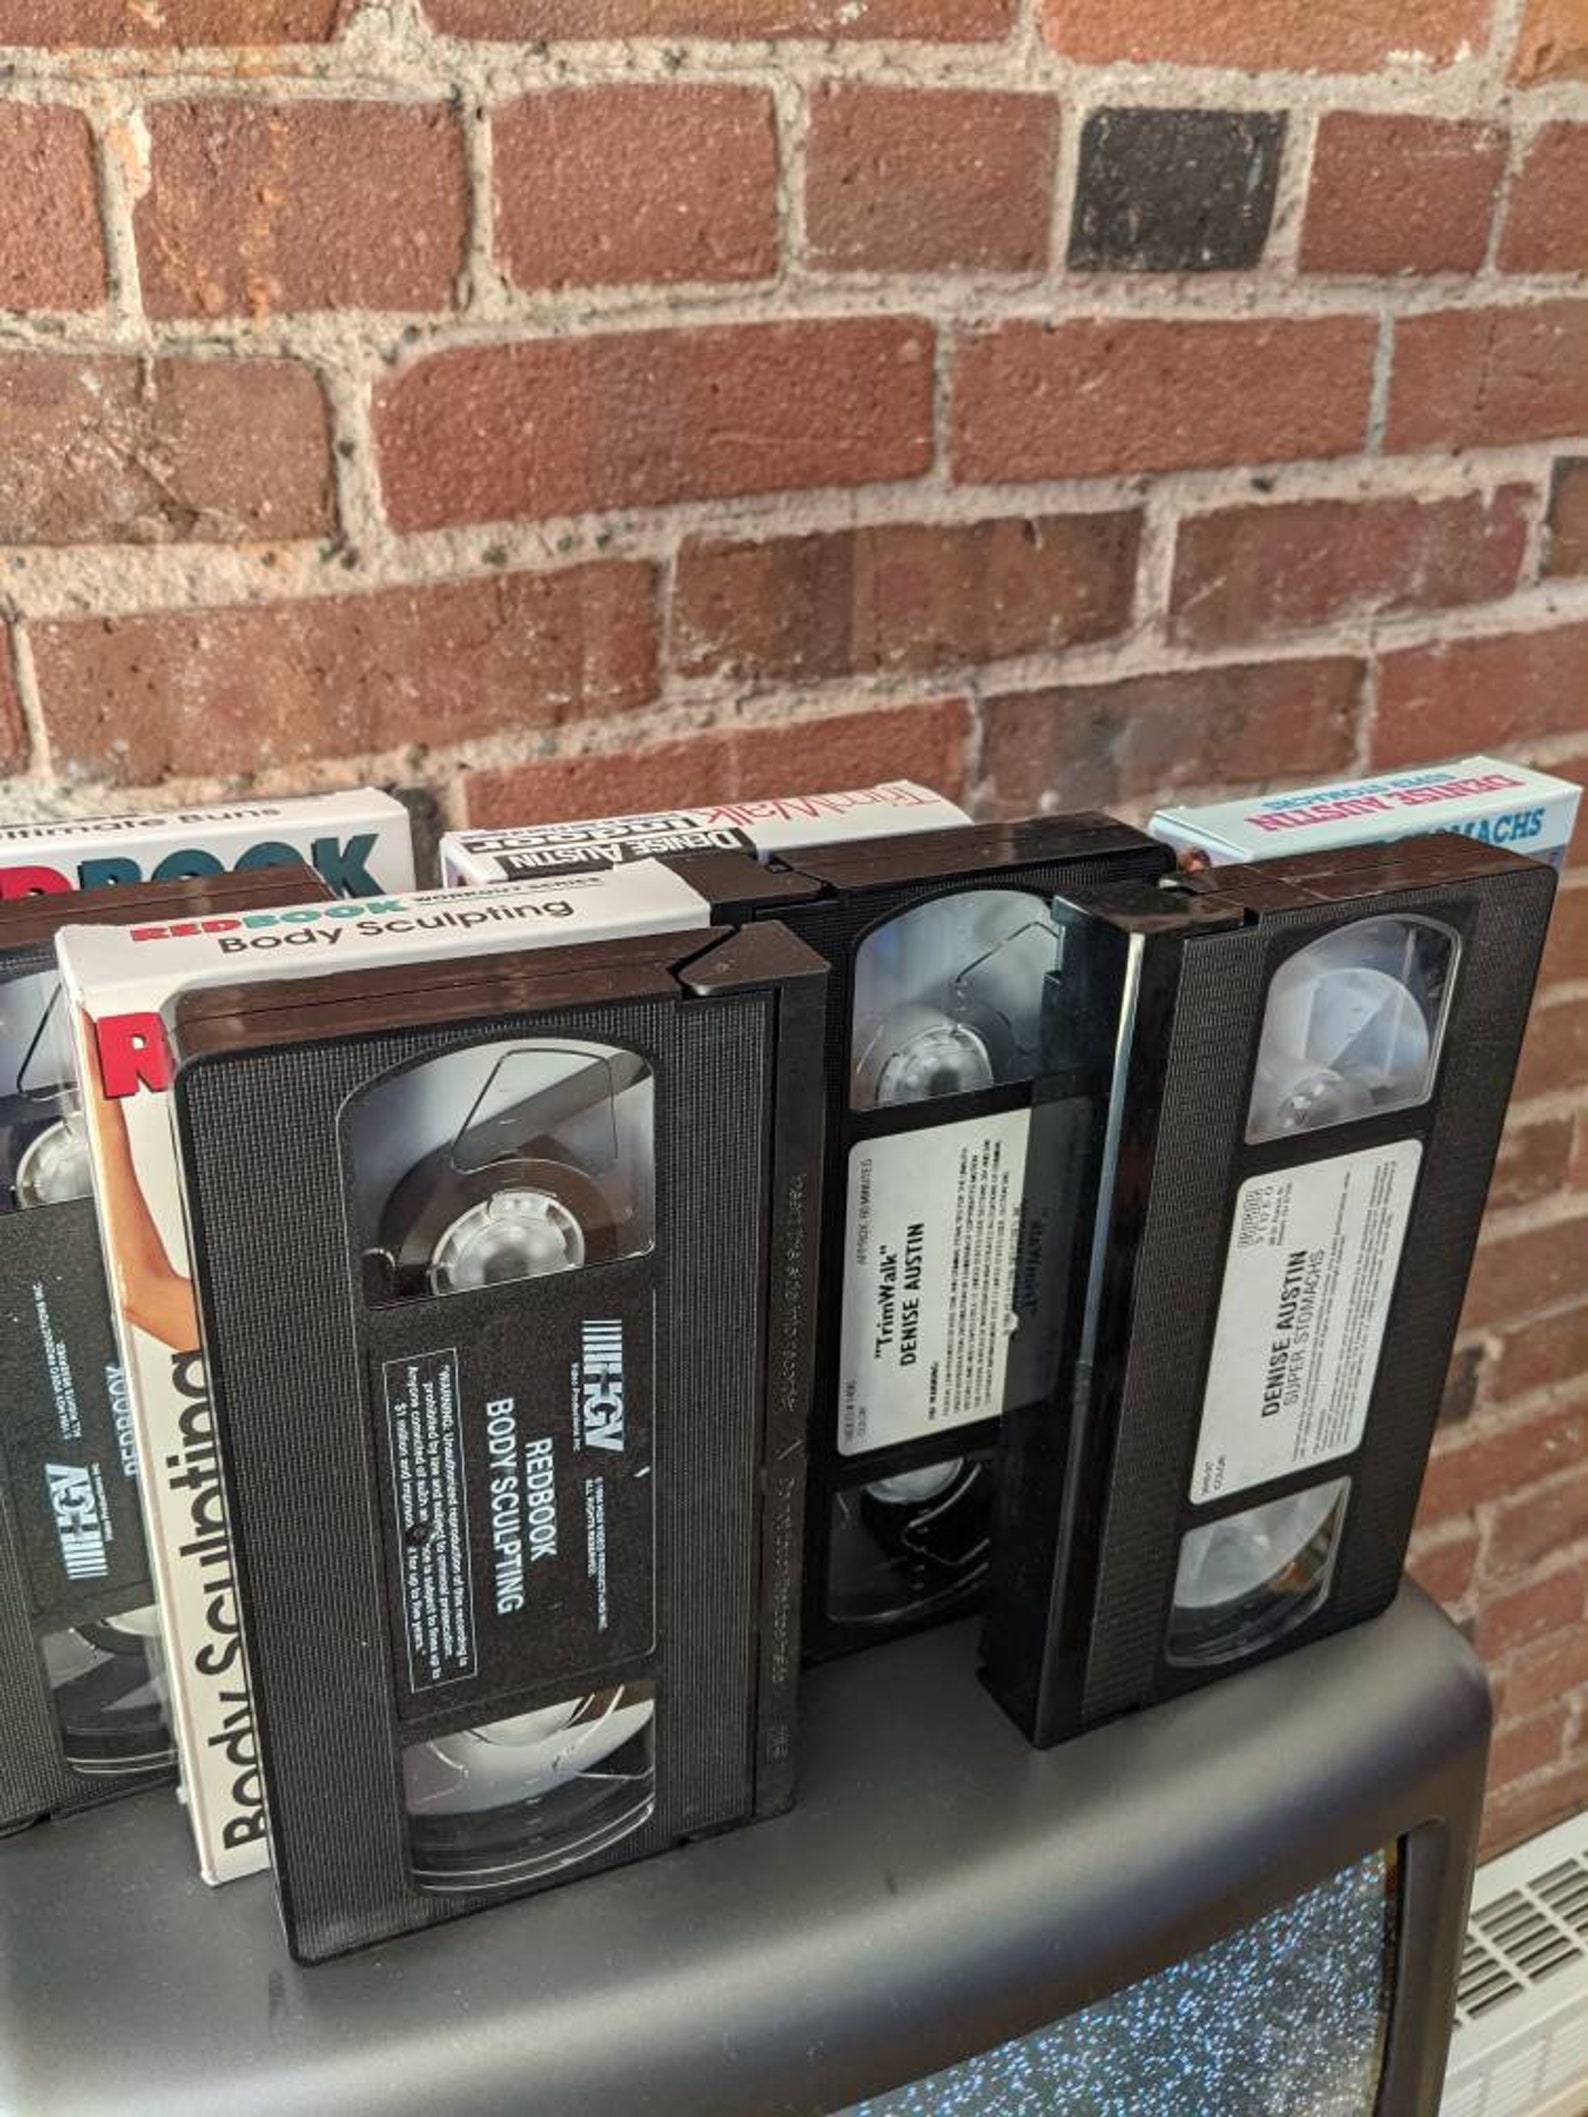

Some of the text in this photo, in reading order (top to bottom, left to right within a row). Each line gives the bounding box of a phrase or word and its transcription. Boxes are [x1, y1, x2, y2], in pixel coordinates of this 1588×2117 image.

[0, 805, 282, 840] ltimate Buns
[695, 787, 942, 828] TrimWalk
[1243, 772, 1527, 832] DENISE AUSTIN
[470, 815, 700, 853] Indoor
[510, 828, 743, 872] DENISE AUSTIN
[130, 899, 407, 942] REDBOOK
[219, 897, 576, 956] Body Sculpting
[874, 1243, 899, 1361] "TrimWalk"
[900, 1222, 925, 1367] DENISE AUSTIN
[1276, 1249, 1308, 1331] AUSTIN
[1292, 1248, 1327, 1346] STOMACHS
[405, 1365, 420, 1408] Anyone
[1261, 1336, 1292, 1419] DENISE
[1283, 1344, 1306, 1408] SUPER
[422, 1381, 438, 1440] prohibited
[399, 1458, 411, 1479] and
[429, 1456, 440, 1475] law
[431, 1477, 441, 1498] and
[486, 1397, 524, 1614] BODY SCULPTING
[525, 1437, 558, 1563] REDBOOK
[446, 1506, 462, 1574] reproduction
[453, 1587, 464, 1607] this
[453, 1608, 467, 1656] recording
[206, 1691, 268, 1850] Body
